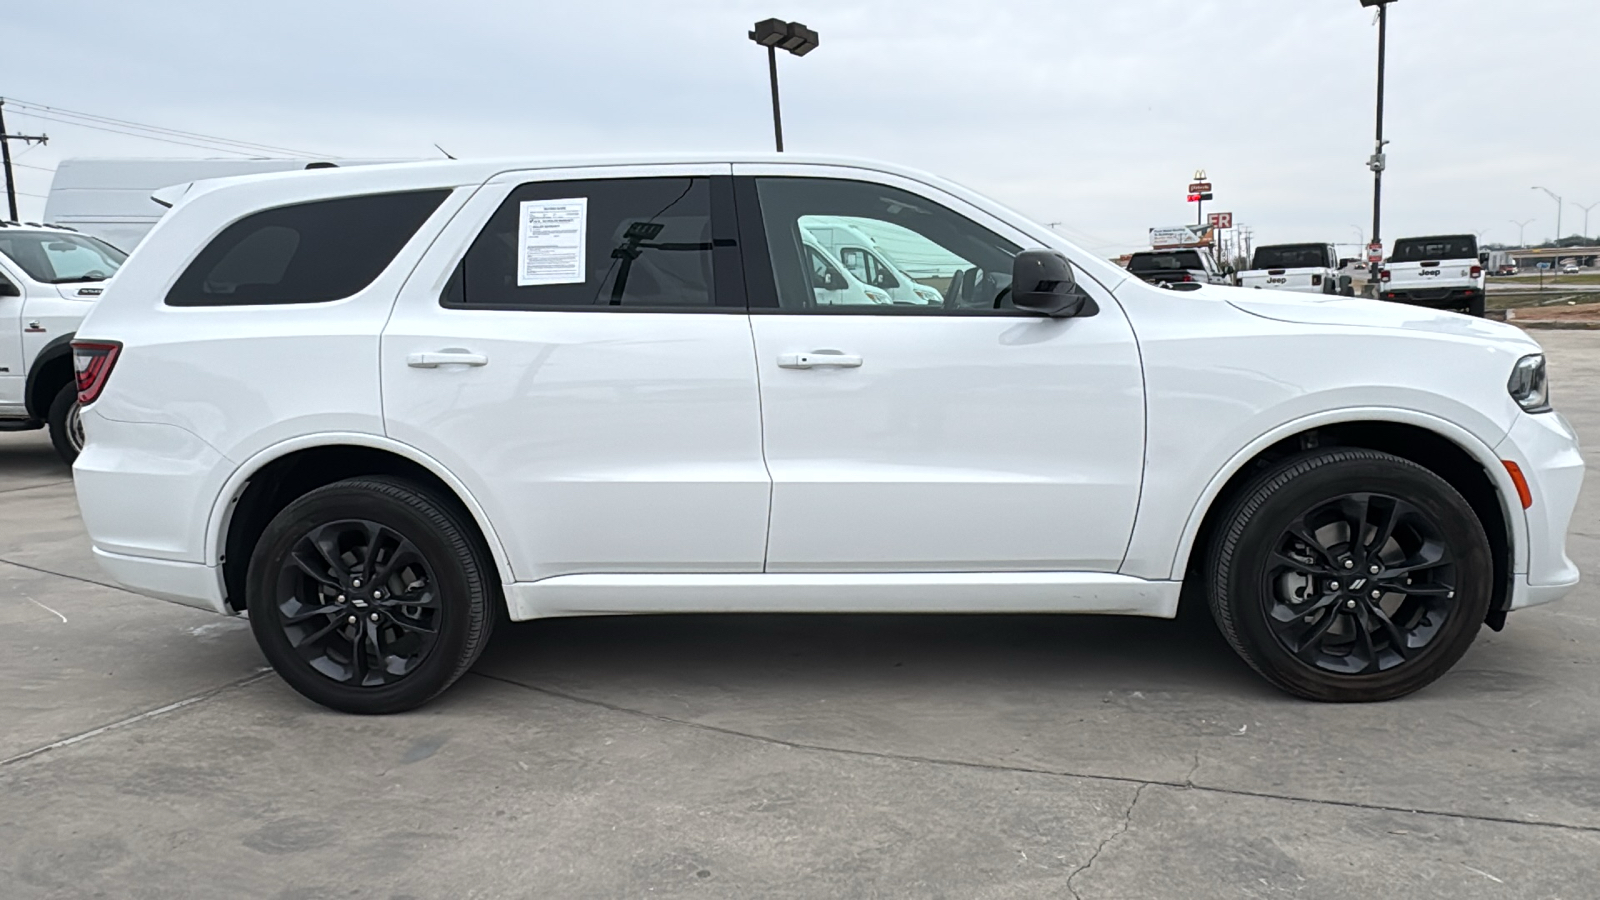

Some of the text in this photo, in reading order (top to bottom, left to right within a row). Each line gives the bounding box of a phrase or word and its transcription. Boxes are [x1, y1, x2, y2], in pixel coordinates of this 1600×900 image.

[1209, 214, 1230, 228] ER
[1418, 269, 1441, 277] Jeep
[1266, 276, 1287, 284] Jeep
